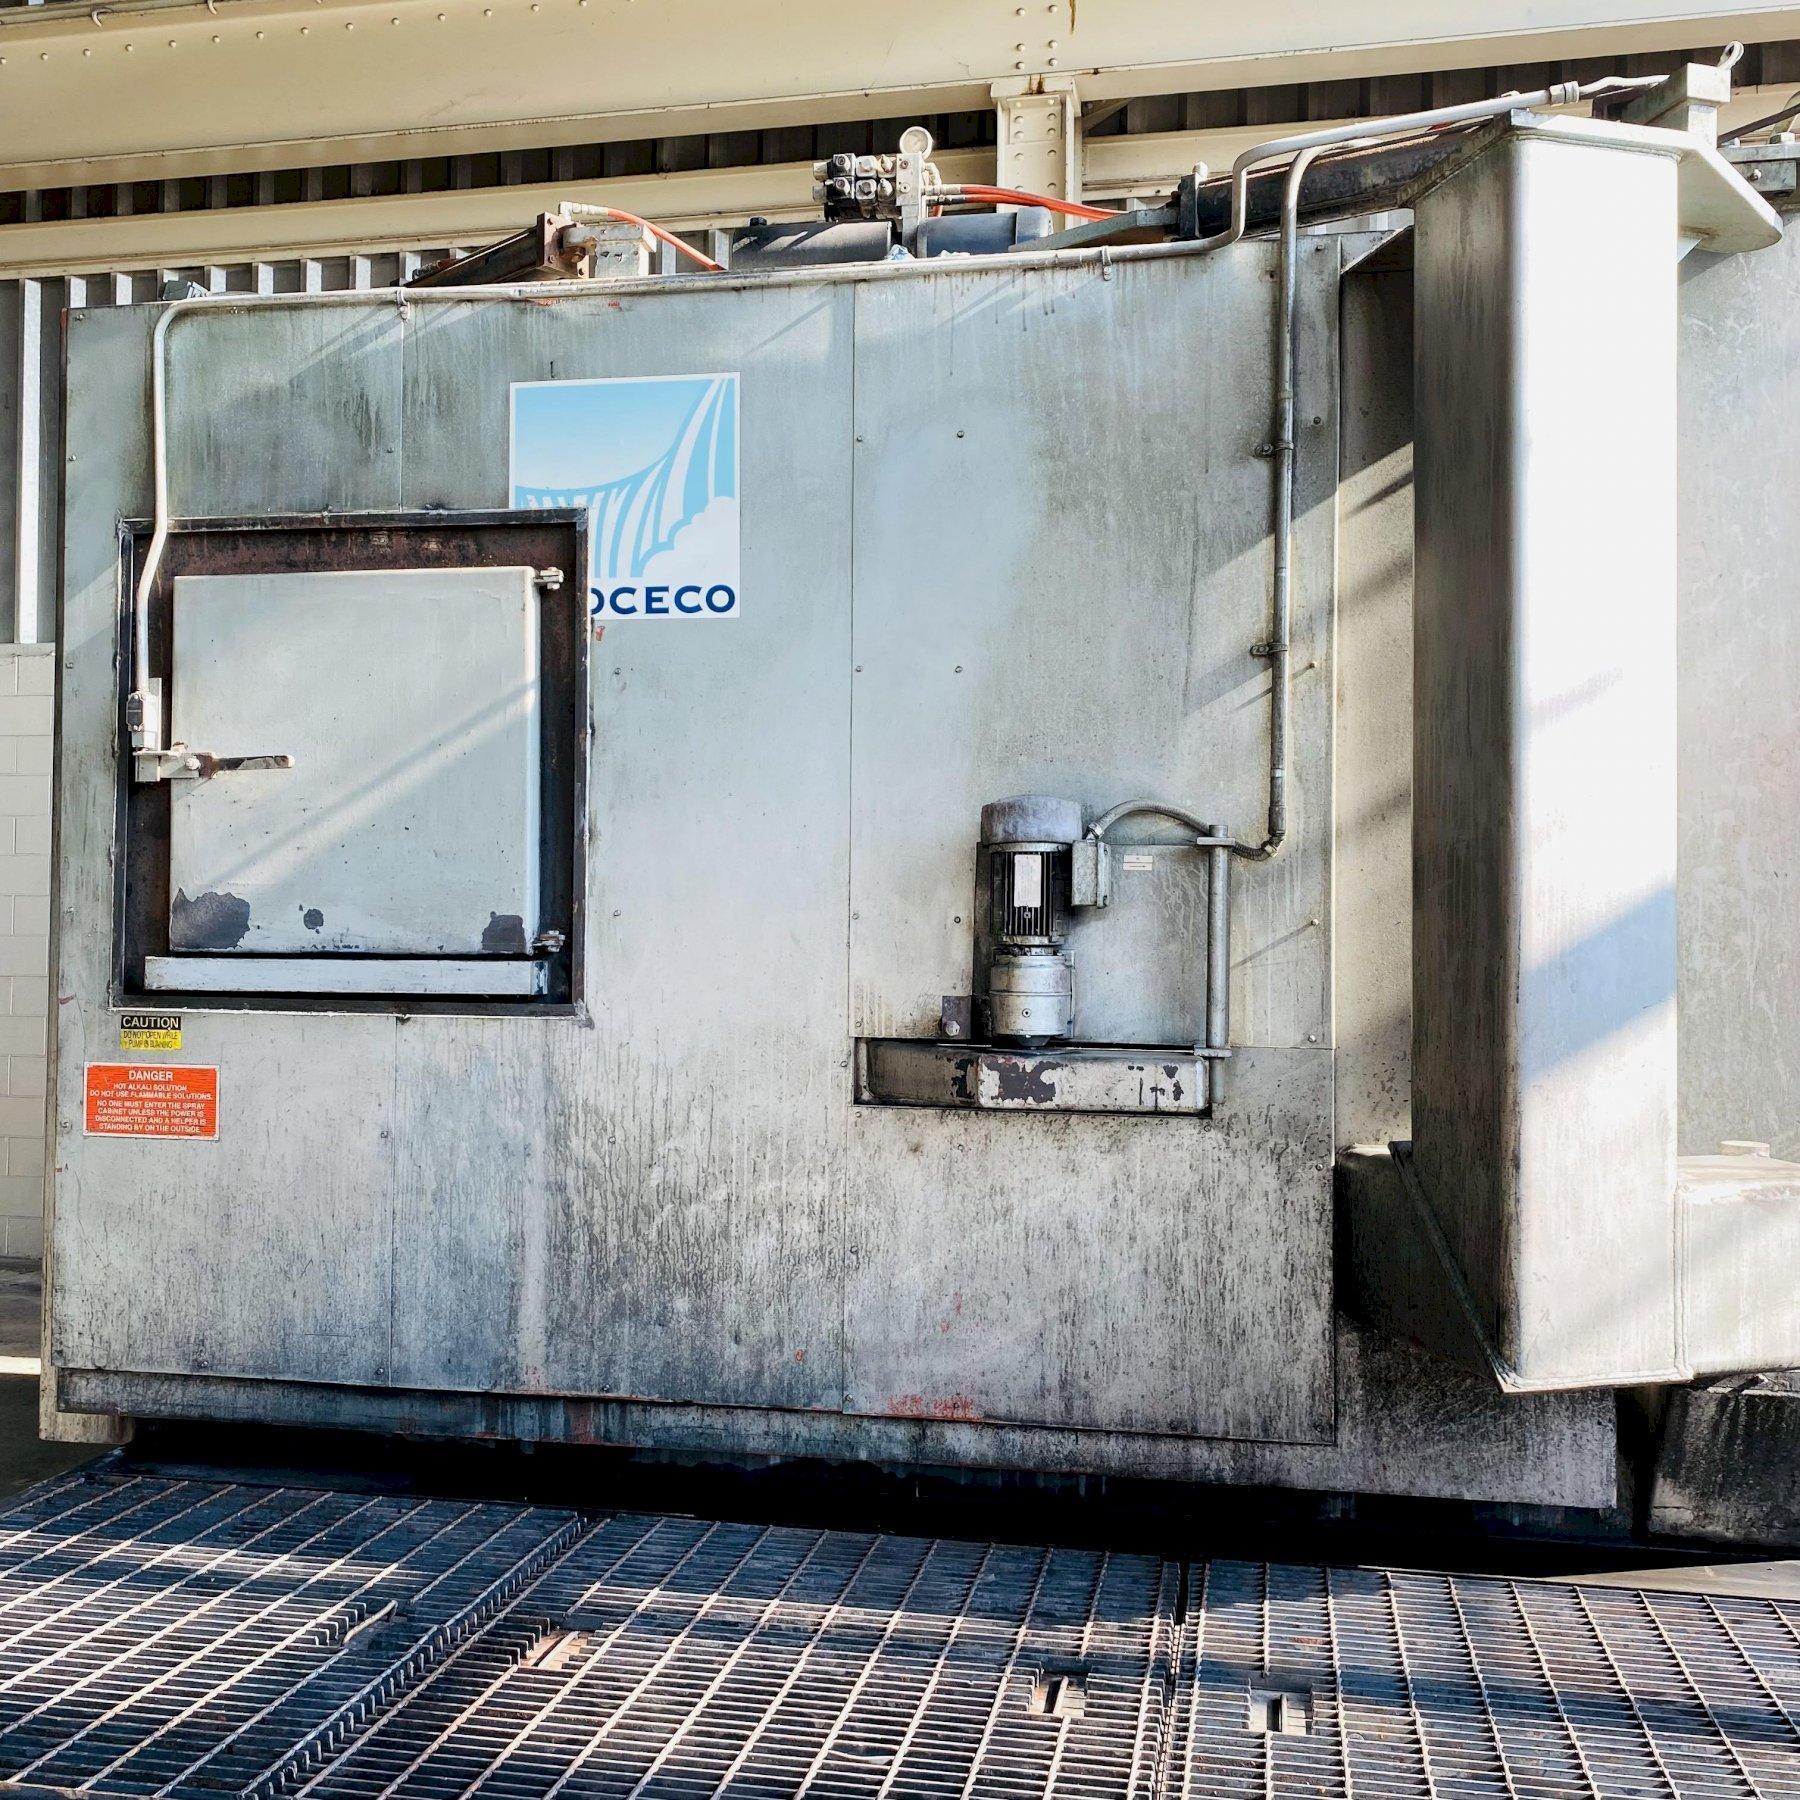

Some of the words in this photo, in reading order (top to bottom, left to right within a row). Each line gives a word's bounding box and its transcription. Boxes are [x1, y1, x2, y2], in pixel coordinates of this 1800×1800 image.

[122, 1016, 179, 1028] CAUTION
[146, 1031, 161, 1039] OPEN
[128, 1070, 174, 1081] DANGER
[130, 1091, 172, 1099] FLAMMABLE
[95, 1115, 147, 1123] DISCONNECTED
